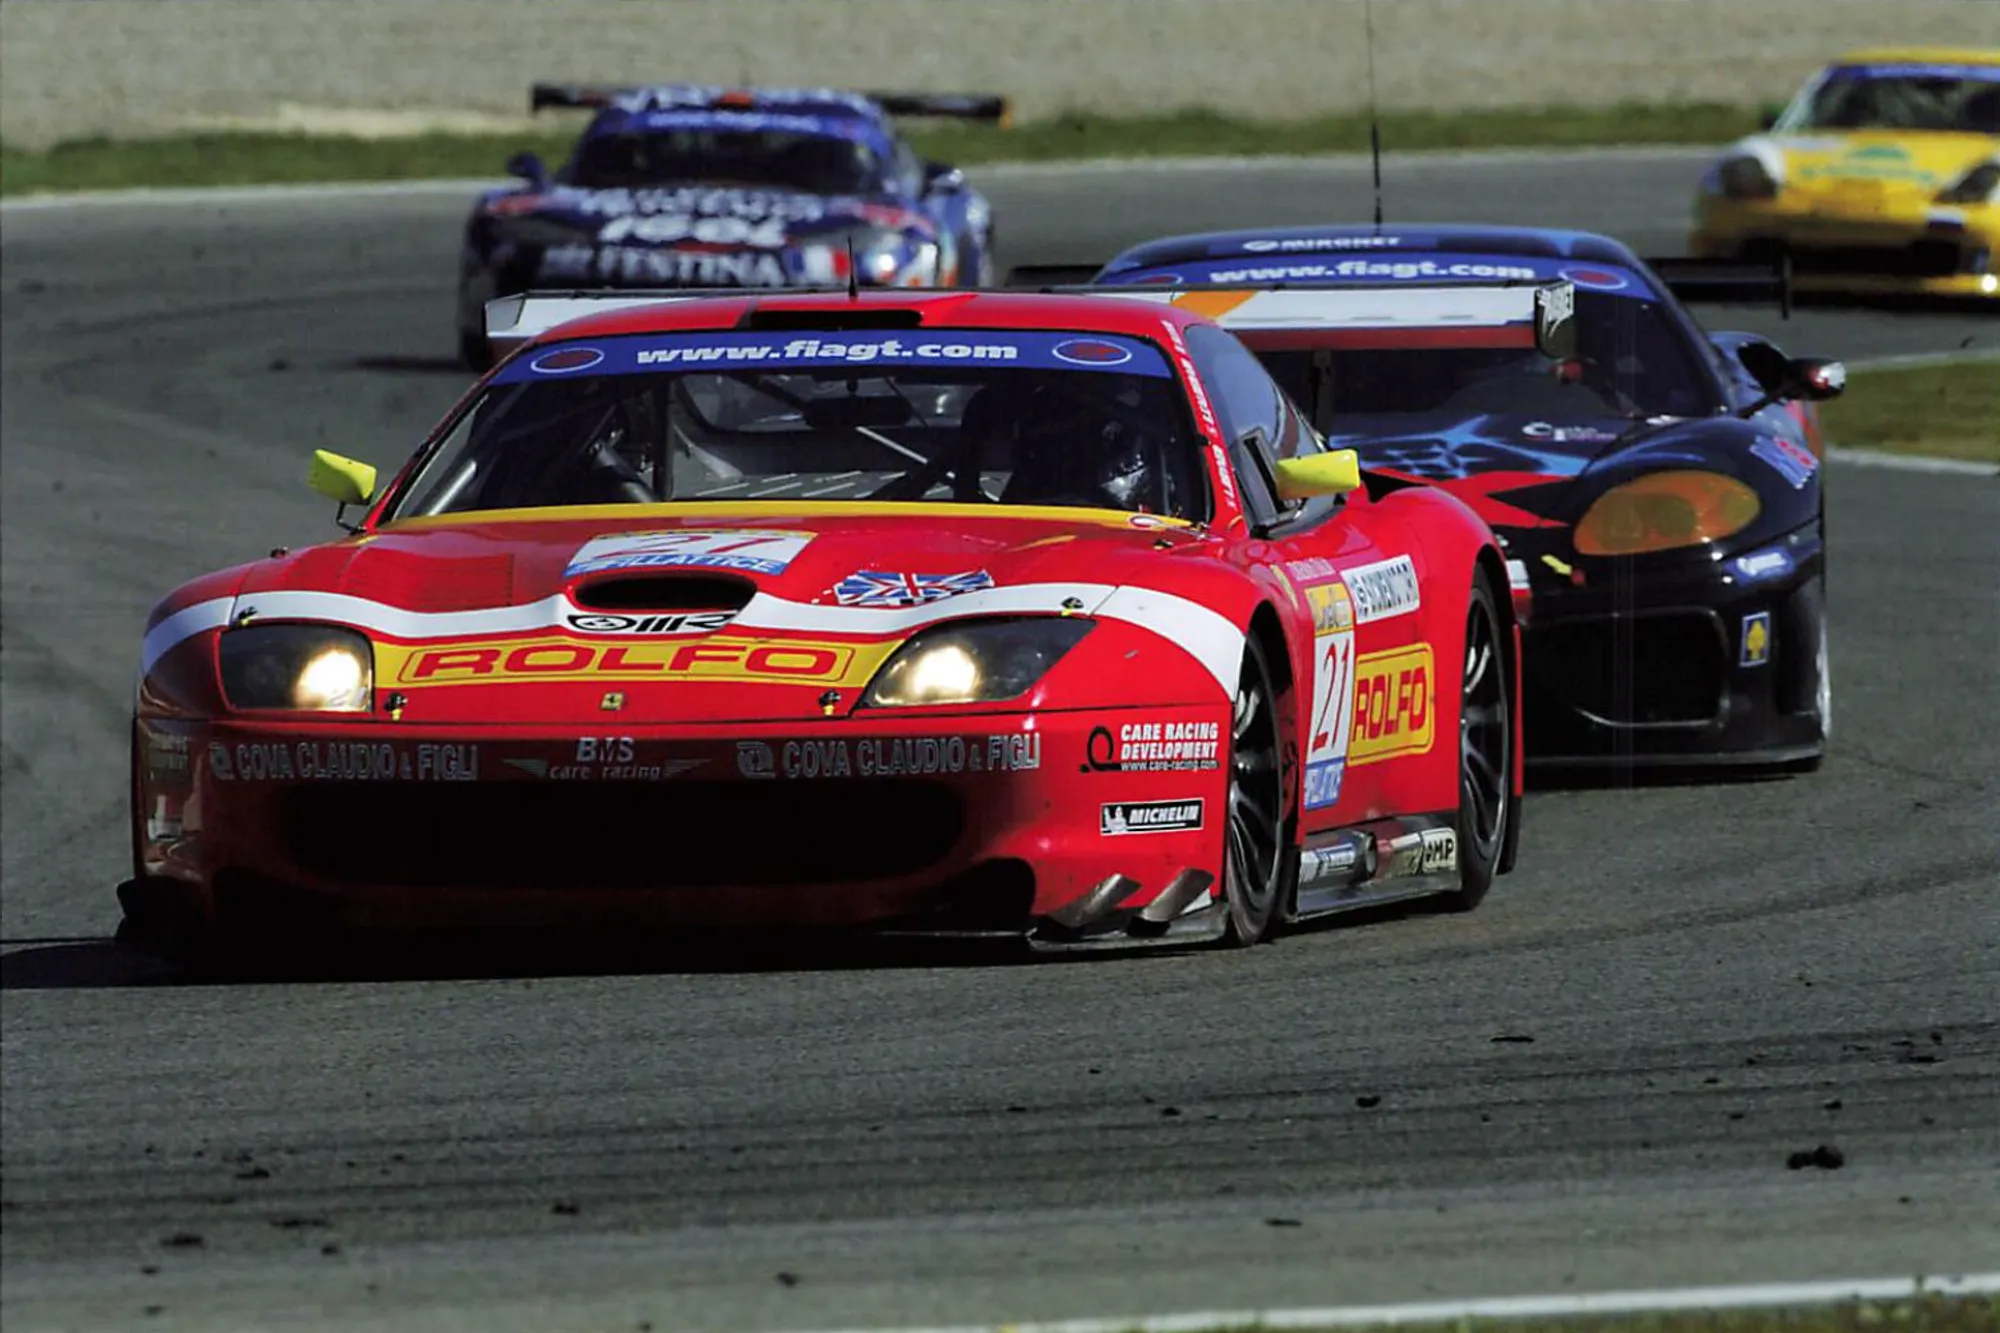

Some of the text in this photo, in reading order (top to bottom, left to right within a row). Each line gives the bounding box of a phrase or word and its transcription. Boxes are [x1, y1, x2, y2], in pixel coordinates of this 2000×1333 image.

[1210, 260, 1536, 284] www.fiagt.com
[636, 339, 1018, 364] www.fiagt.com
[412, 644, 837, 678] ROLFO
[1311, 639, 1351, 752] 21
[1351, 666, 1427, 742] ROLFO
[1121, 722, 1218, 740] CARE RACING
[237, 743, 294, 779] COVA
[297, 742, 396, 779] CLAUDIO
[417, 744, 478, 780] FIGLI
[782, 740, 851, 778] COVA
[857, 735, 965, 775] CLAUDIO
[986, 732, 1041, 771] FIGLI
[1121, 741, 1219, 760] DEVELOPMENT
[550, 765, 591, 780] care
[1129, 805, 1200, 824] MICHELIN
